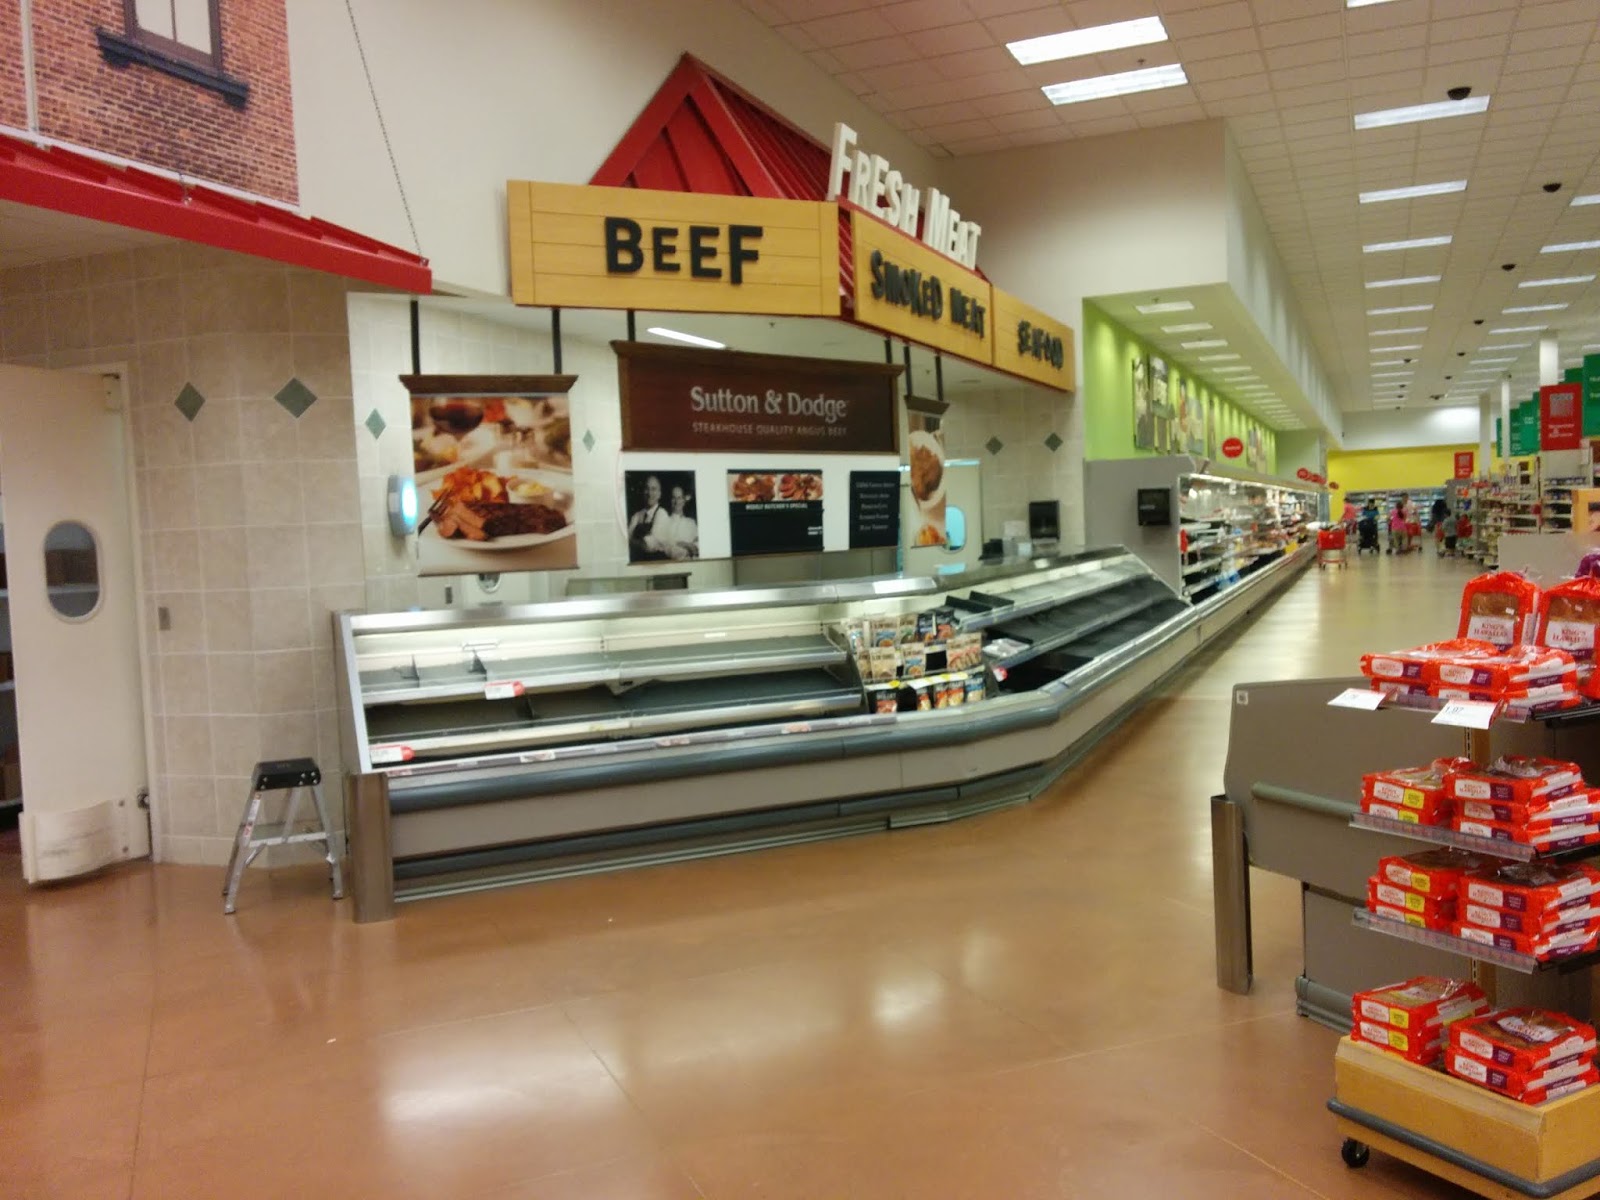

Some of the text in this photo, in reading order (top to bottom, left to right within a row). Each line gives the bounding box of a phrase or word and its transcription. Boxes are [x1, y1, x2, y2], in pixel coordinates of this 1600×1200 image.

[827, 122, 982, 270] FRESH MEAT
[605, 217, 763, 285] BEEF
[870, 249, 986, 340] SMOKED MEAT
[690, 386, 847, 424] Sutton & Dodge
[692, 422, 753, 435] STEAKHOUSE
[756, 424, 794, 435] QUALITY
[797, 426, 826, 436] ANGUS
